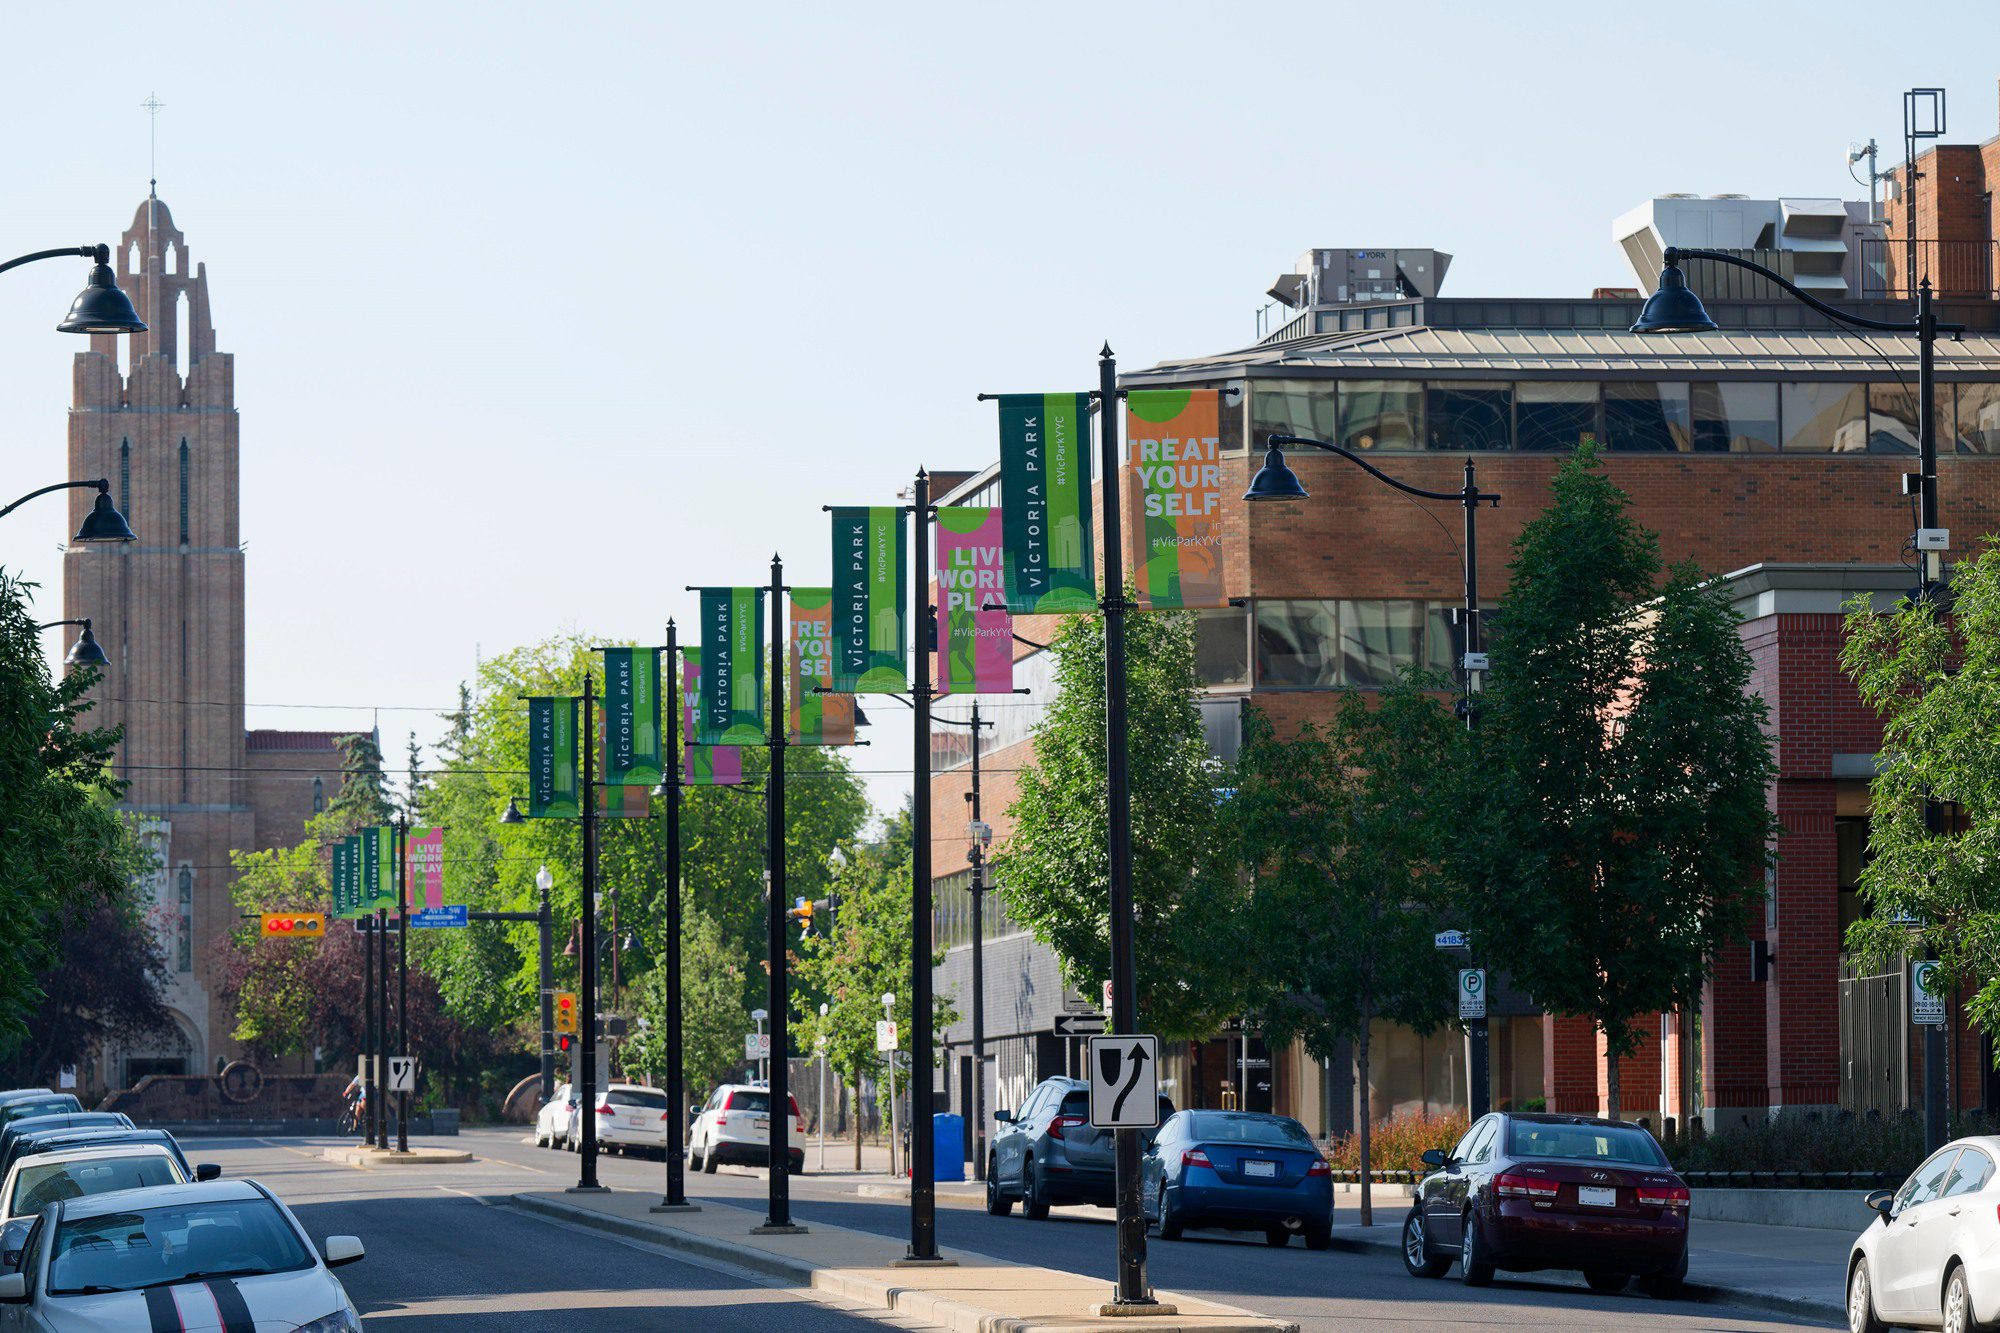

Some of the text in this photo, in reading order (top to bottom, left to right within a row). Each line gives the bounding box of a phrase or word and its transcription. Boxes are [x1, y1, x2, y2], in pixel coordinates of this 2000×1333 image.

[1366, 251, 1386, 259] YORK
[1055, 416, 1066, 485] #VicParkYYC
[1128, 437, 1219, 462] TREAT
[1135, 465, 1220, 489] YOUR
[1023, 416, 1045, 588] VICTORIA PARK
[1145, 492, 1220, 517] SELF
[878, 525, 886, 583] #VicParkYYC
[1152, 536, 1222, 547] #VicParkYYC
[848, 525, 868, 666] VICTORIA PARK
[739, 603, 747, 652] #VicParkYYC
[794, 640, 832, 656] YOU
[714, 604, 732, 723] VICTORIA PARK
[617, 661, 632, 766] VICTORIA PARK
[540, 746, 553, 801] VICTORIA
[409, 854, 442, 862] WORK
[417, 844, 442, 853] LIVE
[370, 860, 379, 898] VICTORIA
[413, 863, 442, 873] PLAY
[351, 866, 360, 903] VICTORIA
[1441, 935, 1463, 945] 4183
[1468, 976, 1477, 989] P
